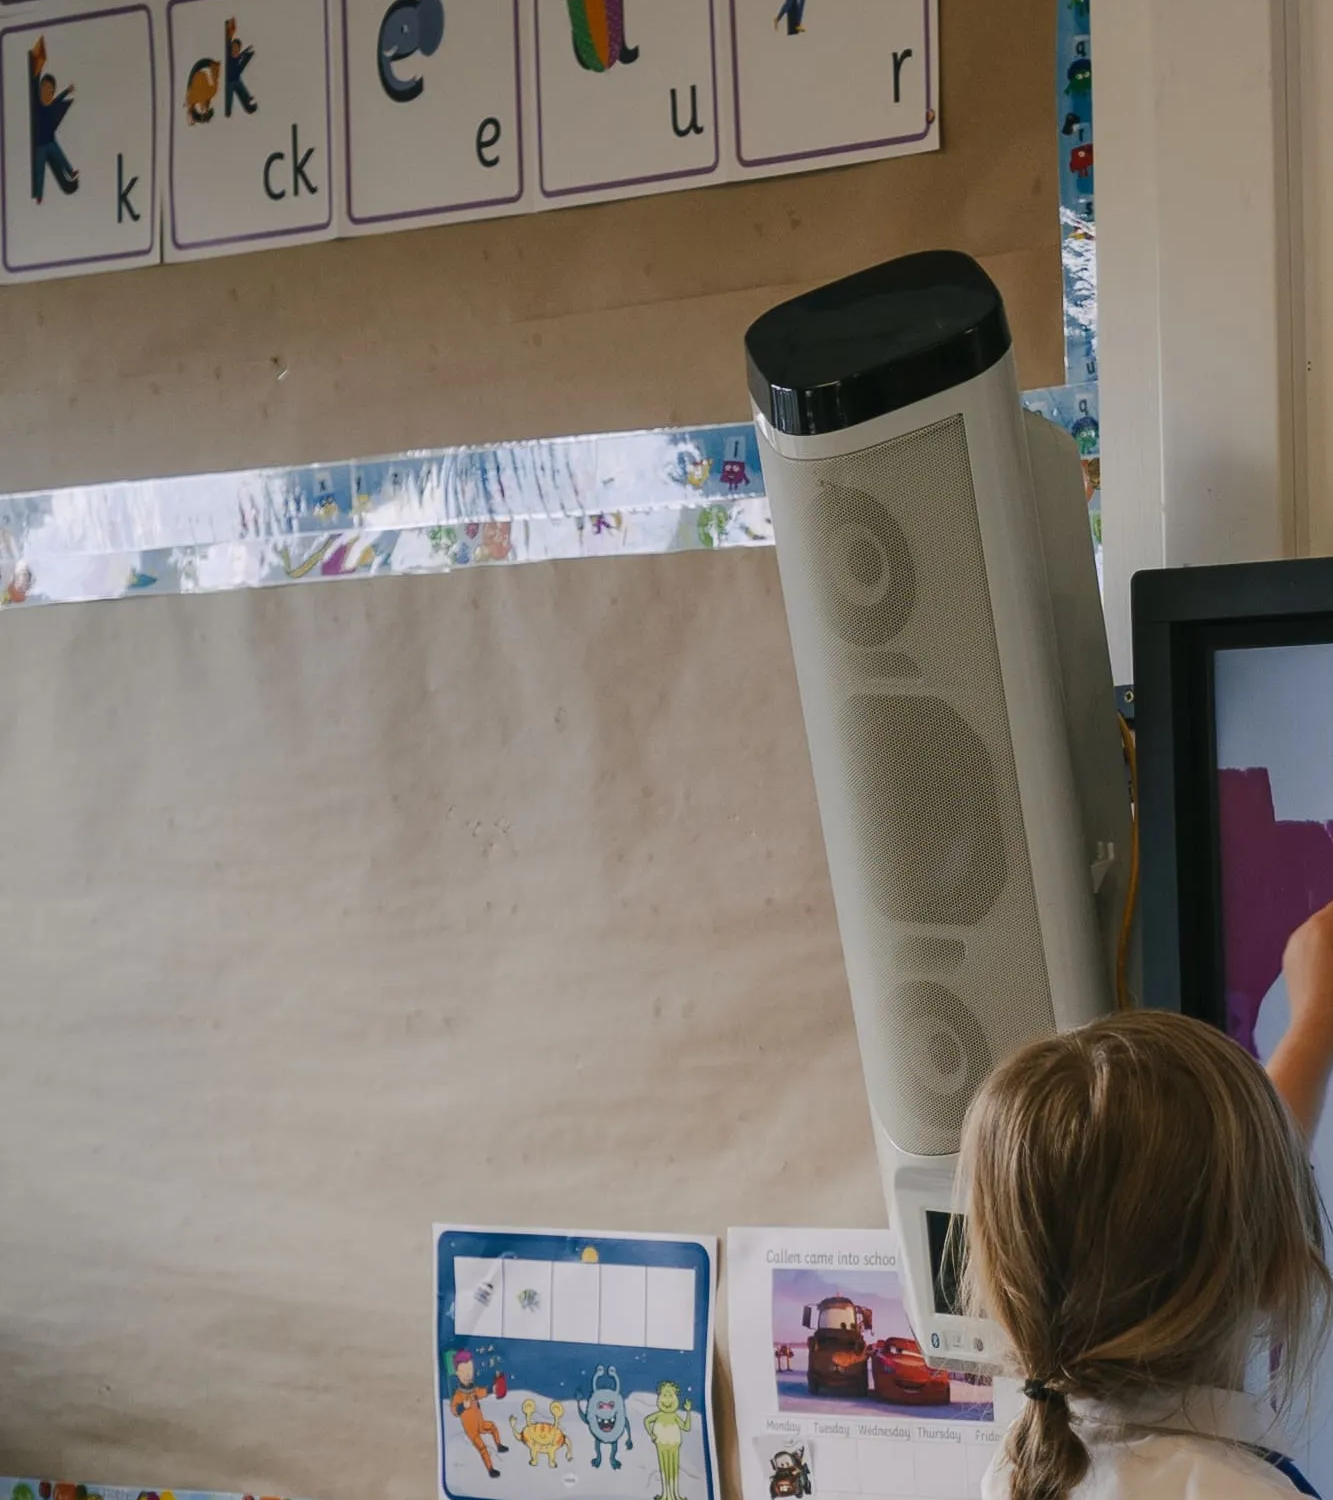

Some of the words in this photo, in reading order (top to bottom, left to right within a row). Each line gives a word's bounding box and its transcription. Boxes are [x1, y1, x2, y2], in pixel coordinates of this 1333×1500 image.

[891, 47, 912, 103] r
[670, 85, 704, 137] u
[262, 124, 318, 200] ck
[475, 116, 502, 168] e
[116, 154, 141, 224] k
[804, 1253, 834, 1265] came
[837, 1251, 860, 1266] into
[863, 1251, 897, 1267] schoo
[766, 1420, 801, 1436] Monday
[813, 1421, 850, 1437] Tuesday
[858, 1424, 911, 1440] Wednesday
[918, 1427, 962, 1444] Thursday
[976, 1429, 1002, 1442] Frida
